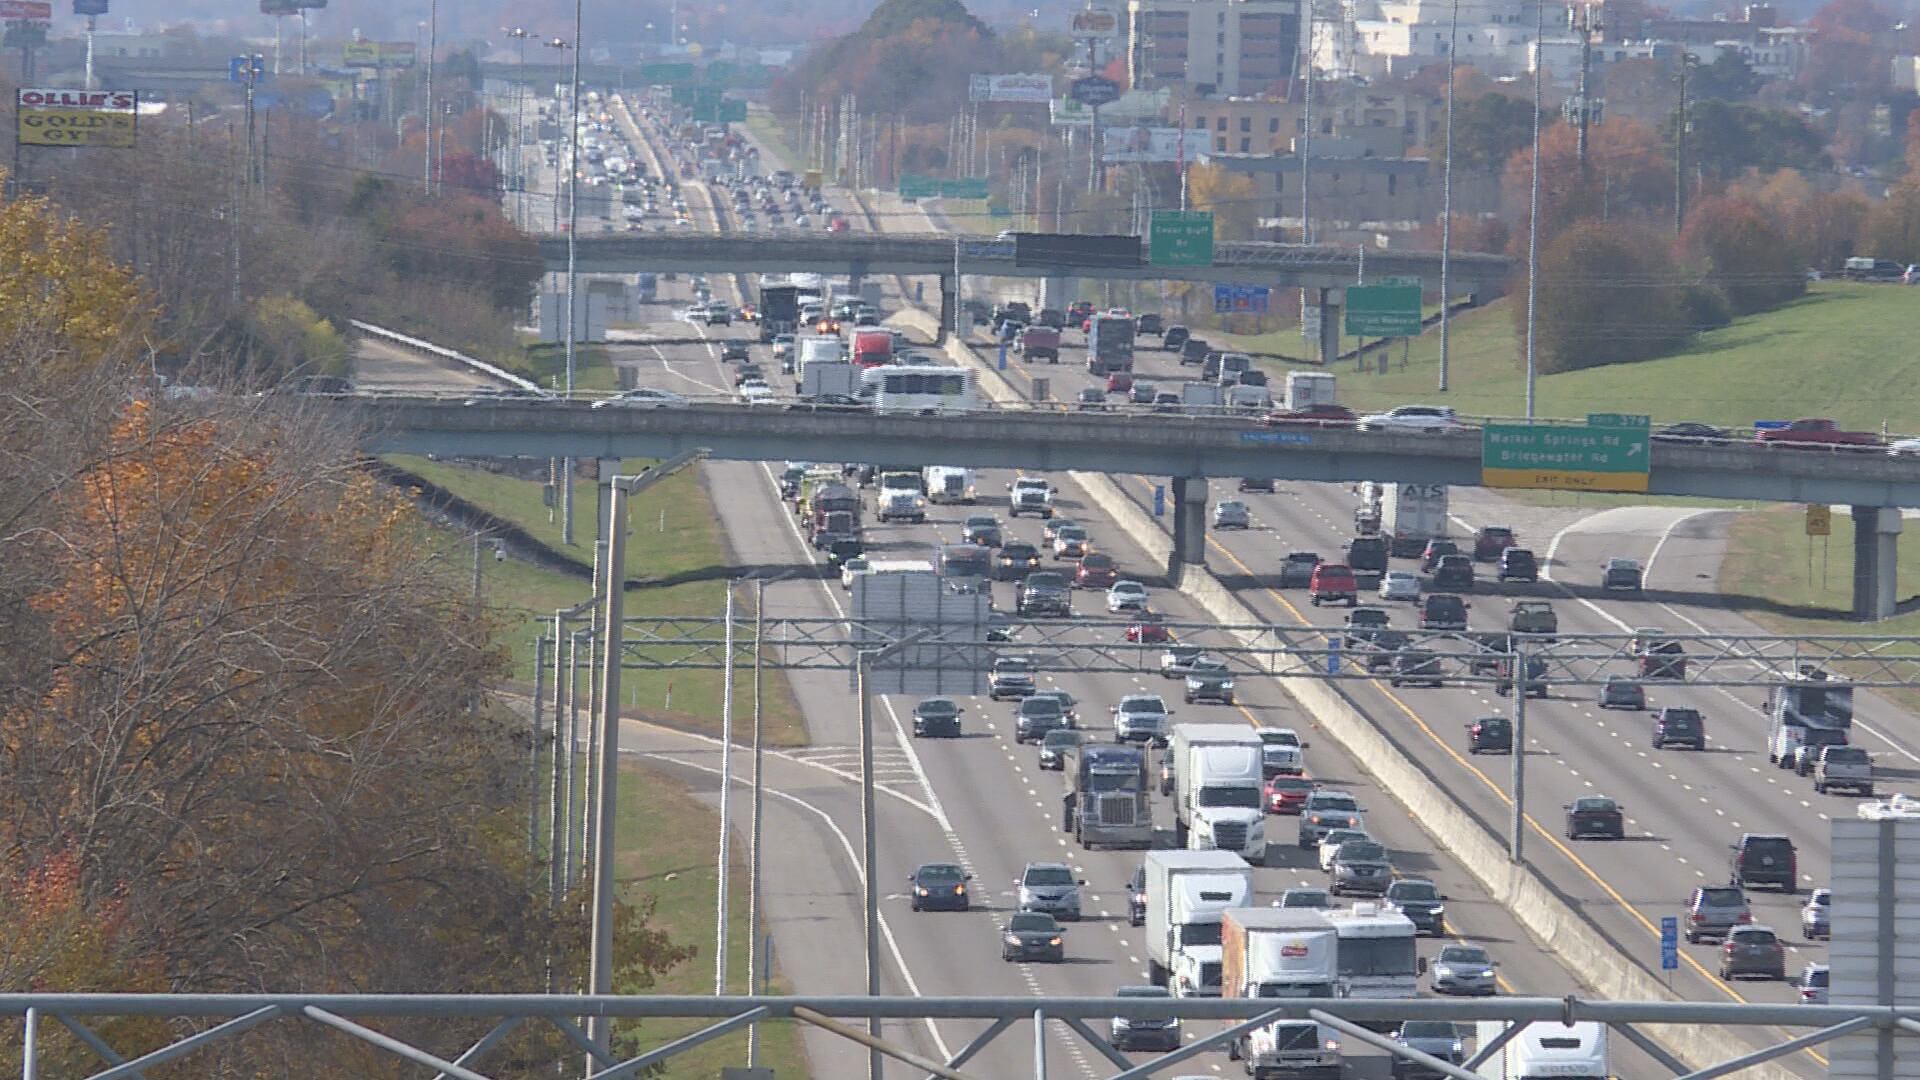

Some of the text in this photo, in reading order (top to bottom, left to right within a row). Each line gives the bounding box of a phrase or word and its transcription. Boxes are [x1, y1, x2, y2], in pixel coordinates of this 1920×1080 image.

[22, 91, 133, 108] OLLIE'S
[1490, 433, 1621, 448] Walker Springs Rd
[1501, 451, 1609, 464] Bridgewater Rd
[1403, 485, 1444, 496] ATS
[1538, 1065, 1589, 1073] VOLVO
